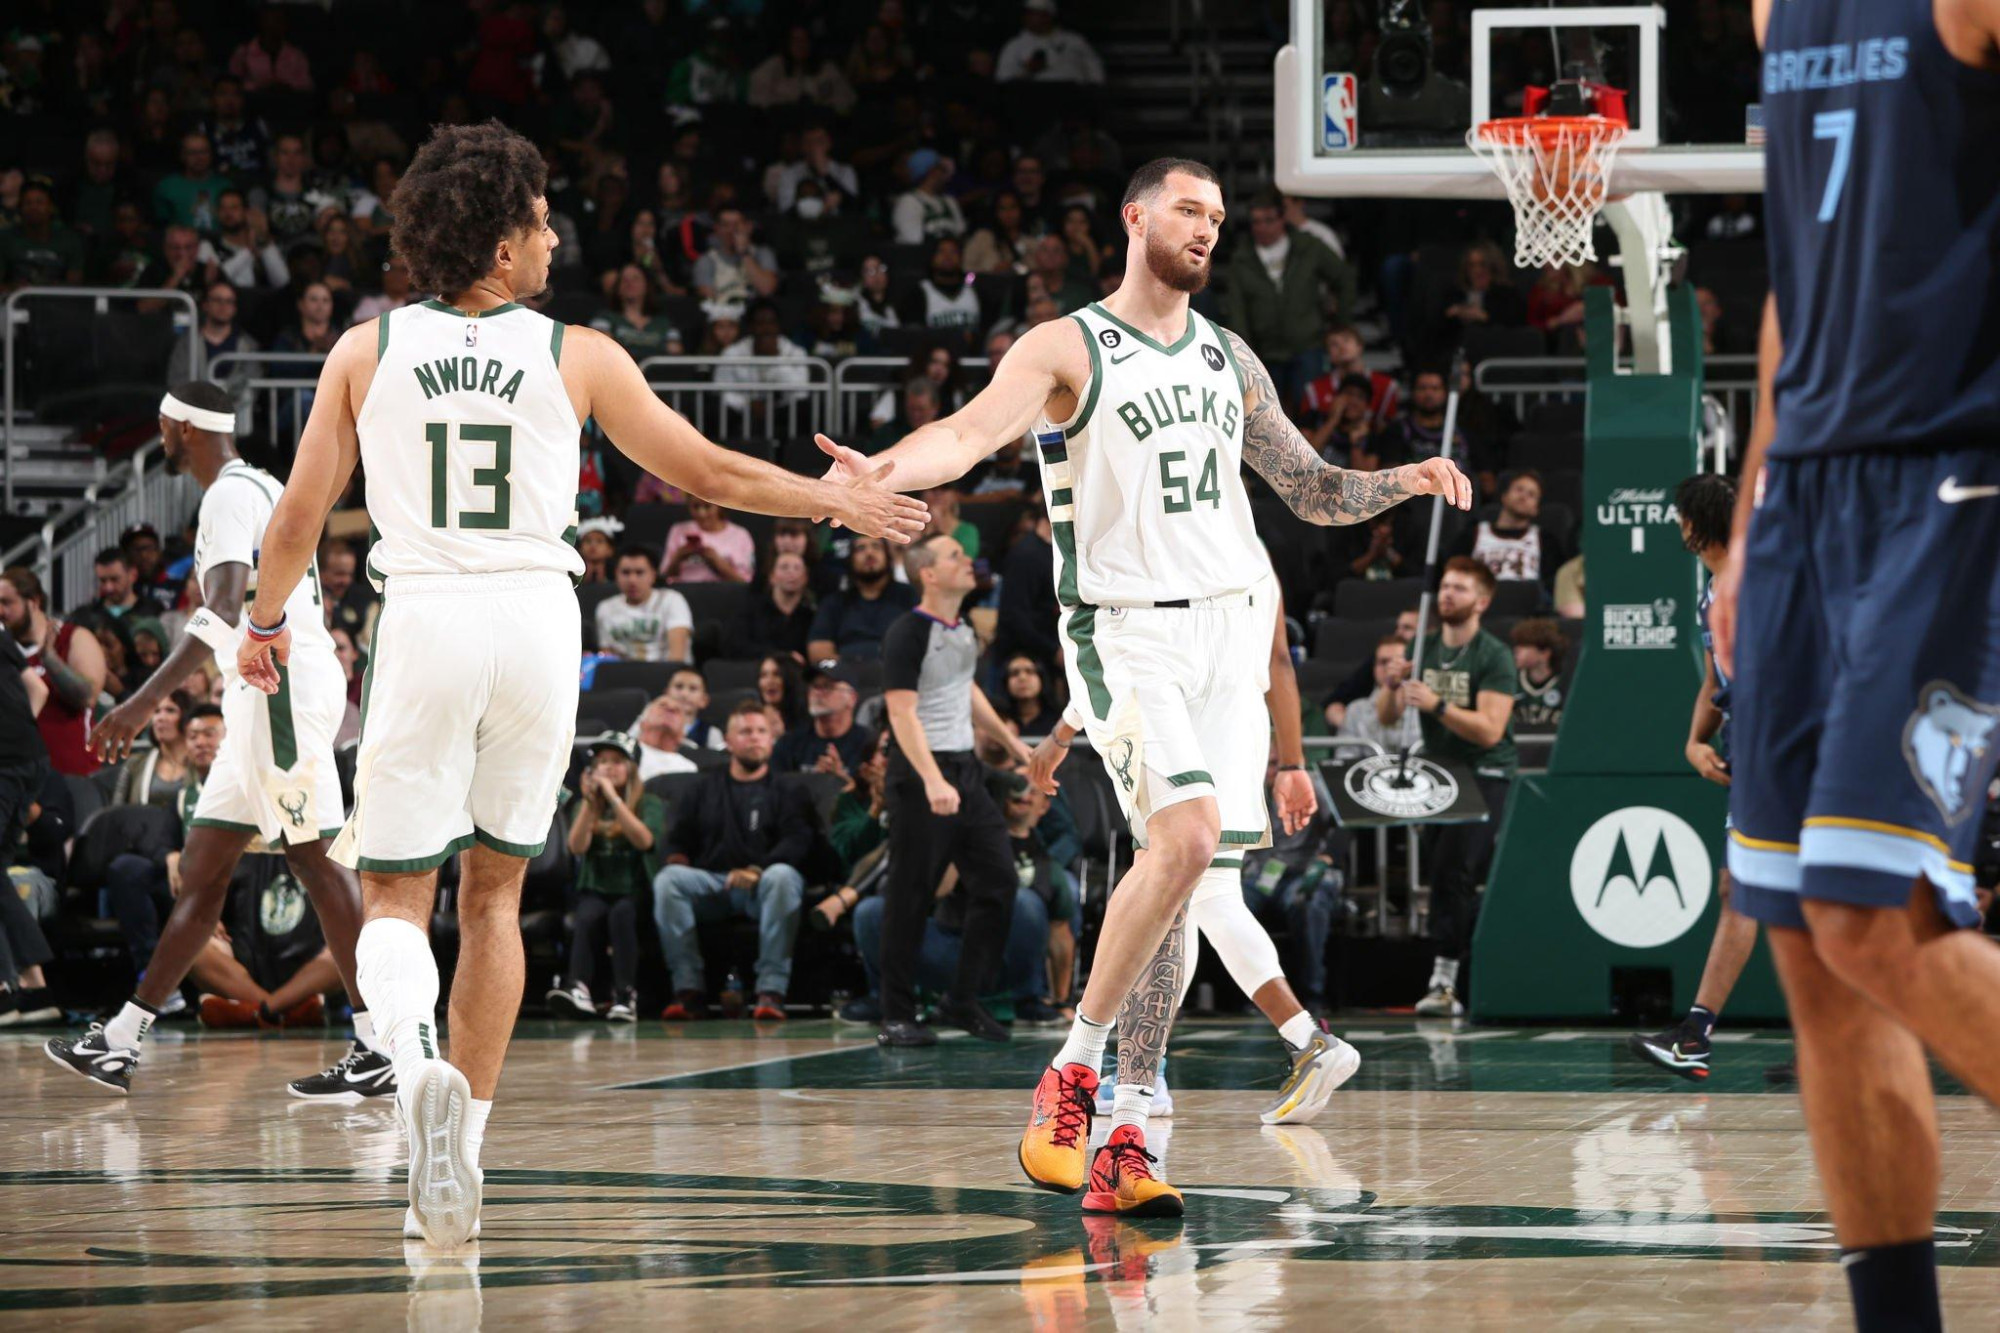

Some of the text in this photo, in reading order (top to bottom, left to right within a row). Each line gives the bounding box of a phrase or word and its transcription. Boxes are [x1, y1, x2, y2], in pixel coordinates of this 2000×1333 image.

[1763, 36, 1909, 94] GRIZZLIES
[1813, 107, 1857, 224] 7
[1102, 332, 1117, 346] 6
[412, 355, 526, 405] NWORA
[1116, 383, 1239, 442] BUCKS
[424, 421, 513, 530] 13
[1158, 447, 1222, 515] 54
[1597, 503, 1683, 525] ULTRA
[1603, 608, 1653, 627] BUCKS
[1603, 627, 1677, 645] PRO SHOP
